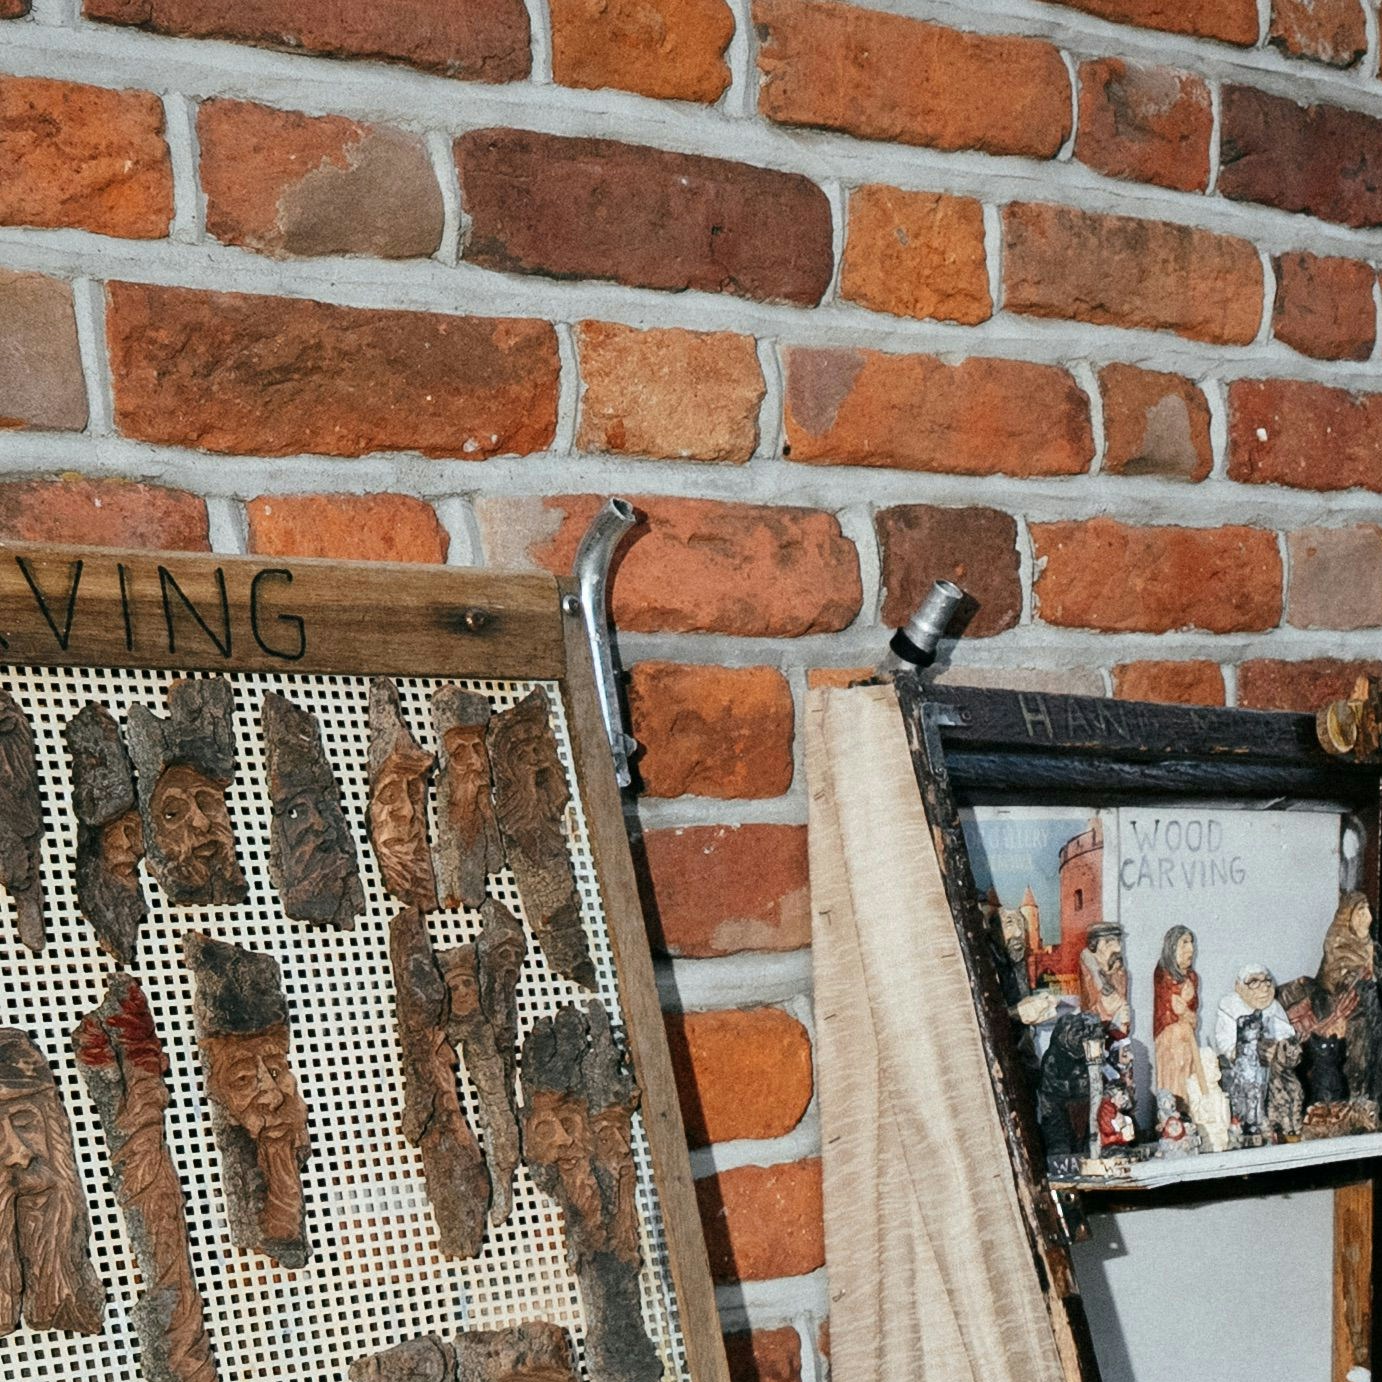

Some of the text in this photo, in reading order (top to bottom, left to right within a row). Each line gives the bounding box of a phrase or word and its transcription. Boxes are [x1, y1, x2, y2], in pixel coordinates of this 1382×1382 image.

[0, 556, 306, 661] VING
[1130, 819, 1224, 854] WOOD
[1119, 855, 1247, 891] CARVING
